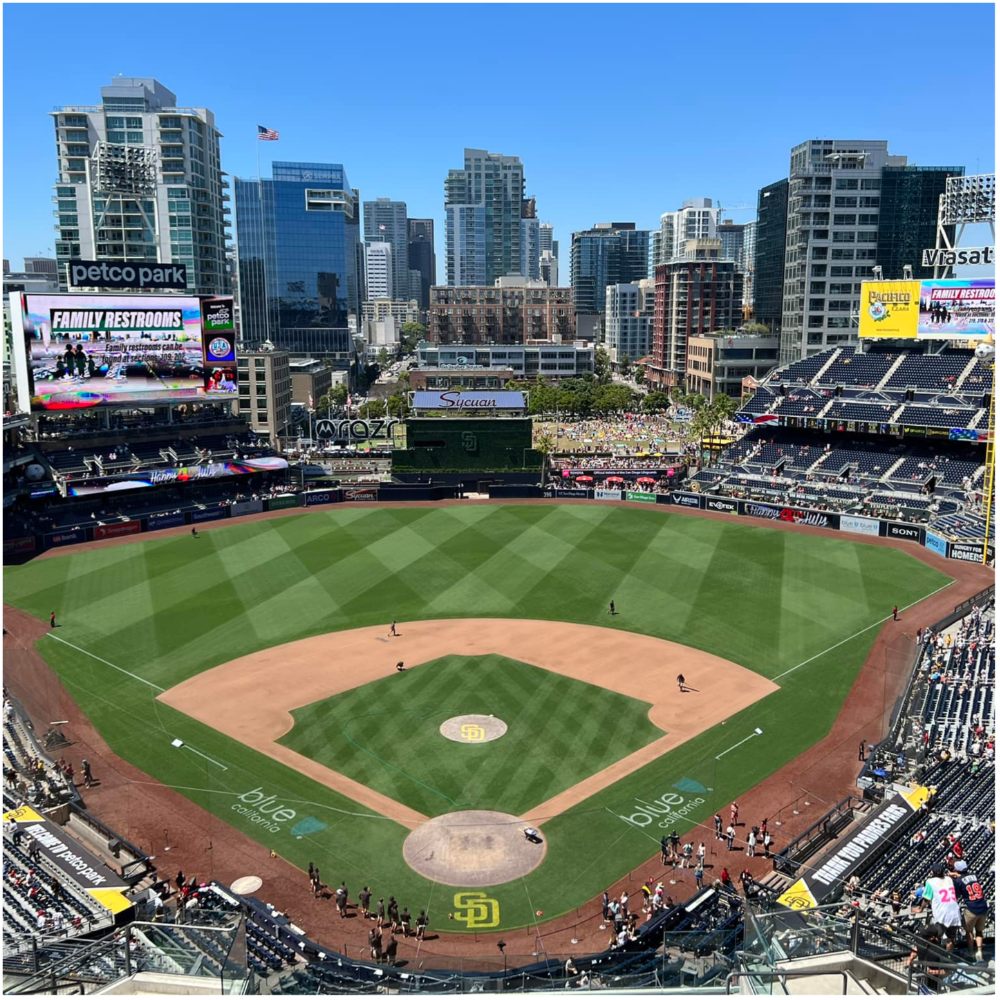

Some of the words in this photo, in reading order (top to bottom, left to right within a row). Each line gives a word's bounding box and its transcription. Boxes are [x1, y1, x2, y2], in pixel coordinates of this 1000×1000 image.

[926, 247, 991, 266] Viasat
[72, 262, 135, 285] petco
[139, 266, 185, 287] park
[932, 288, 960, 299] FAMILY
[53, 311, 103, 328] FAMILY
[104, 311, 181, 328] RESTROOMS
[207, 313, 230, 321] petco
[211, 319, 230, 327] park
[105, 343, 128, 353] Family
[438, 391, 498, 412] Sycuan
[338, 420, 400, 439] razr
[307, 493, 329, 502] ARCO
[892, 527, 919, 537] SONY
[926, 535, 939, 548] petco
[954, 544, 973, 552] HUNGRY
[951, 550, 984, 562] HOMERS
[461, 724, 485, 741] SD
[237, 787, 297, 824] blue
[621, 792, 685, 828] blue
[658, 796, 706, 829] california
[231, 802, 281, 834] california
[811, 854, 851, 886] THANK
[837, 841, 865, 862] YOU
[852, 818, 891, 849] PADRES
[878, 804, 908, 825] FANS
[56, 851, 88, 871] petco
[77, 868, 106, 886] park
[966, 882, 983, 900] 19
[454, 891, 500, 928] SD
